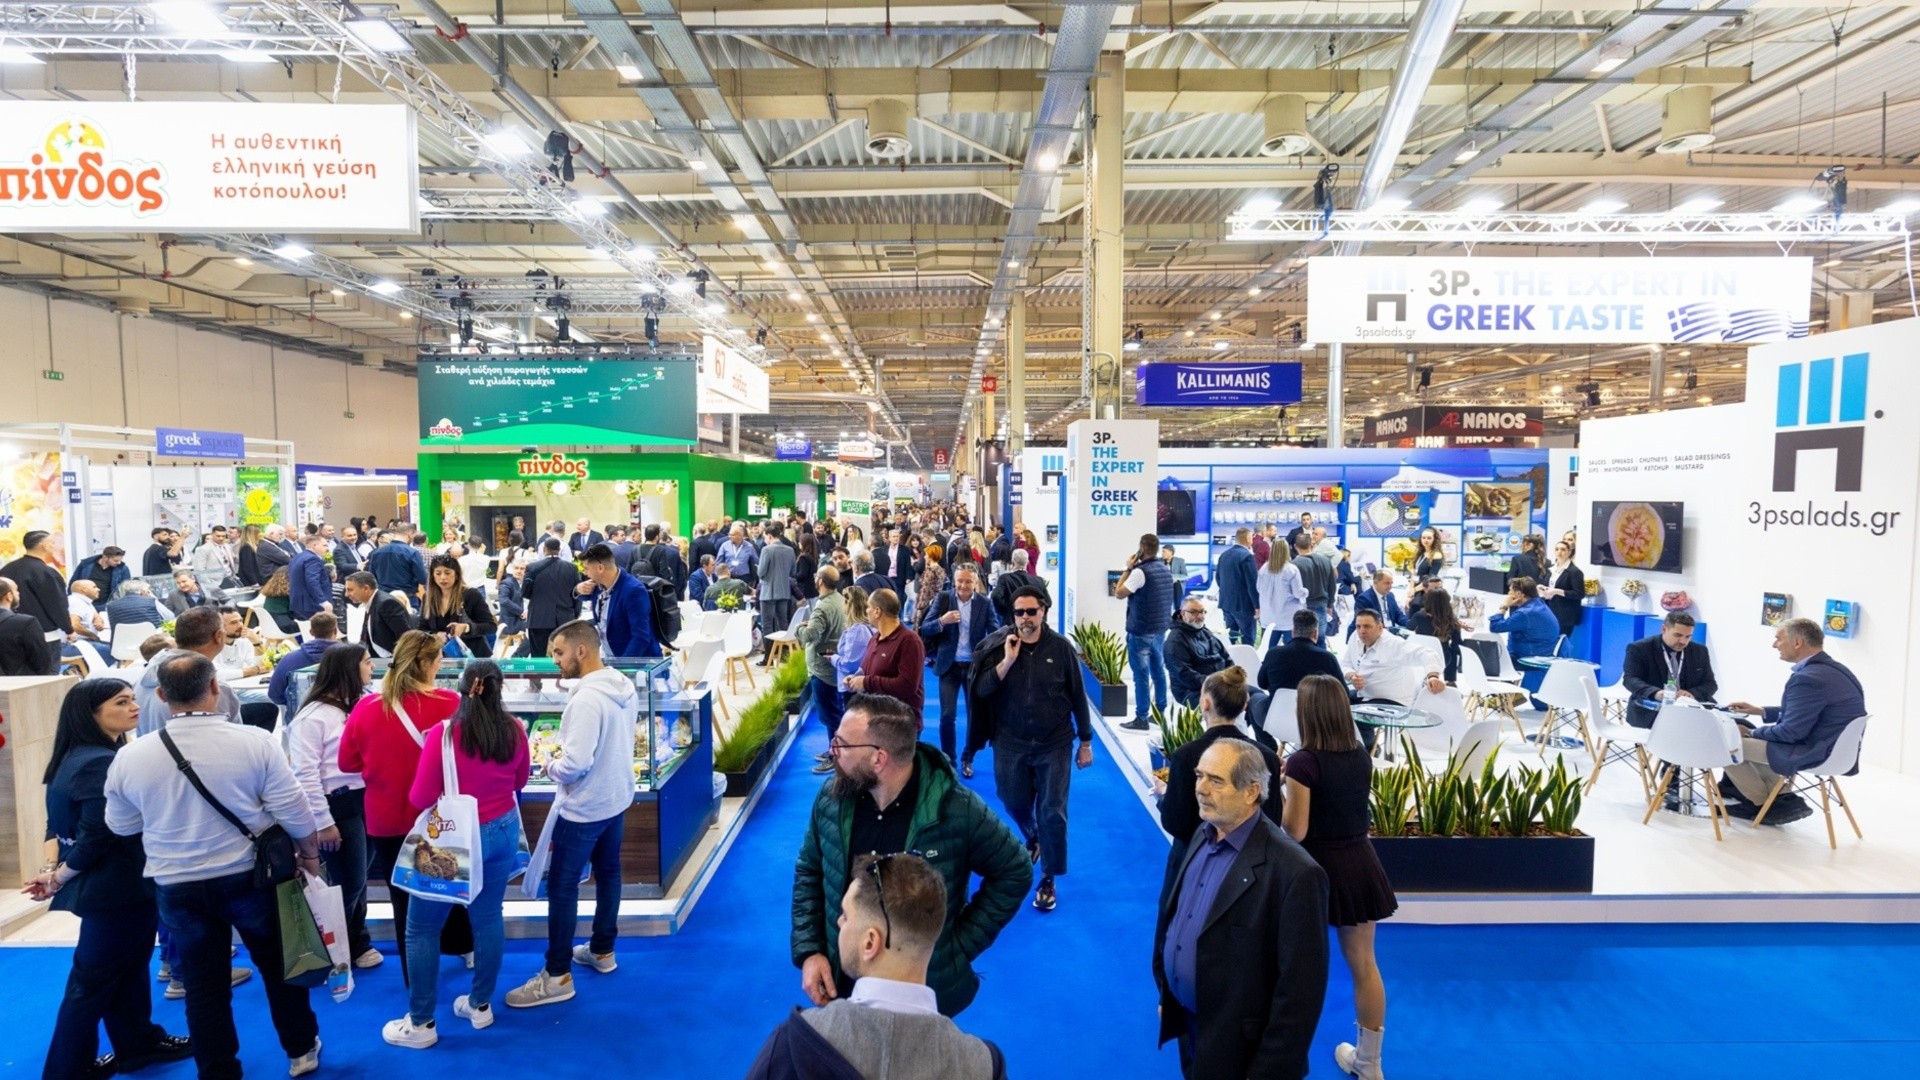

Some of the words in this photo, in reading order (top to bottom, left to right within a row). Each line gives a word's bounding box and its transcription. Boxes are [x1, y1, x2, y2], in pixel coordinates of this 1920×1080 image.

[212, 133, 225, 150] Η
[234, 134, 342, 154] αυθεντική
[212, 157, 305, 178] ελληνική
[314, 160, 377, 179] γεύση
[0, 151, 162, 212] πίνδος
[213, 182, 347, 200] κοτόπουλου!
[1428, 269, 1481, 297] 3P.
[1494, 270, 1553, 296] THE
[1567, 270, 1685, 296] EXPERT
[1701, 270, 1737, 296] IN
[1427, 303, 1536, 331] GREEK
[1547, 304, 1644, 331] TASTE
[1355, 325, 1417, 340] 3psalads.gr
[435, 365, 471, 376] Σταθερή
[472, 365, 502, 376] αύξηση
[504, 365, 550, 376] παραγωγής
[552, 365, 588, 374] νεοσσών
[468, 376, 484, 386] ανά
[486, 376, 521, 387] χιλιάδες
[522, 376, 555, 387] τεμάχια
[1176, 371, 1271, 390] KALLIMANIS
[1376, 416, 1408, 436] NANOS
[1463, 412, 1526, 429] NANOS
[1092, 432, 1115, 444] 3P.
[936, 453, 946, 463] B
[1092, 446, 1118, 458] THE
[1639, 456, 1668, 464] CHUTNEYS
[1674, 454, 1693, 462] SALAD
[1695, 453, 1731, 461] DRESSINGS
[518, 454, 586, 478] πίνδος
[1092, 461, 1145, 473] EXPERT
[1092, 475, 1108, 487] IN
[1091, 489, 1138, 502] GREEK
[1091, 504, 1133, 516] TASTE
[1748, 500, 1900, 536] 3psalads.gr
